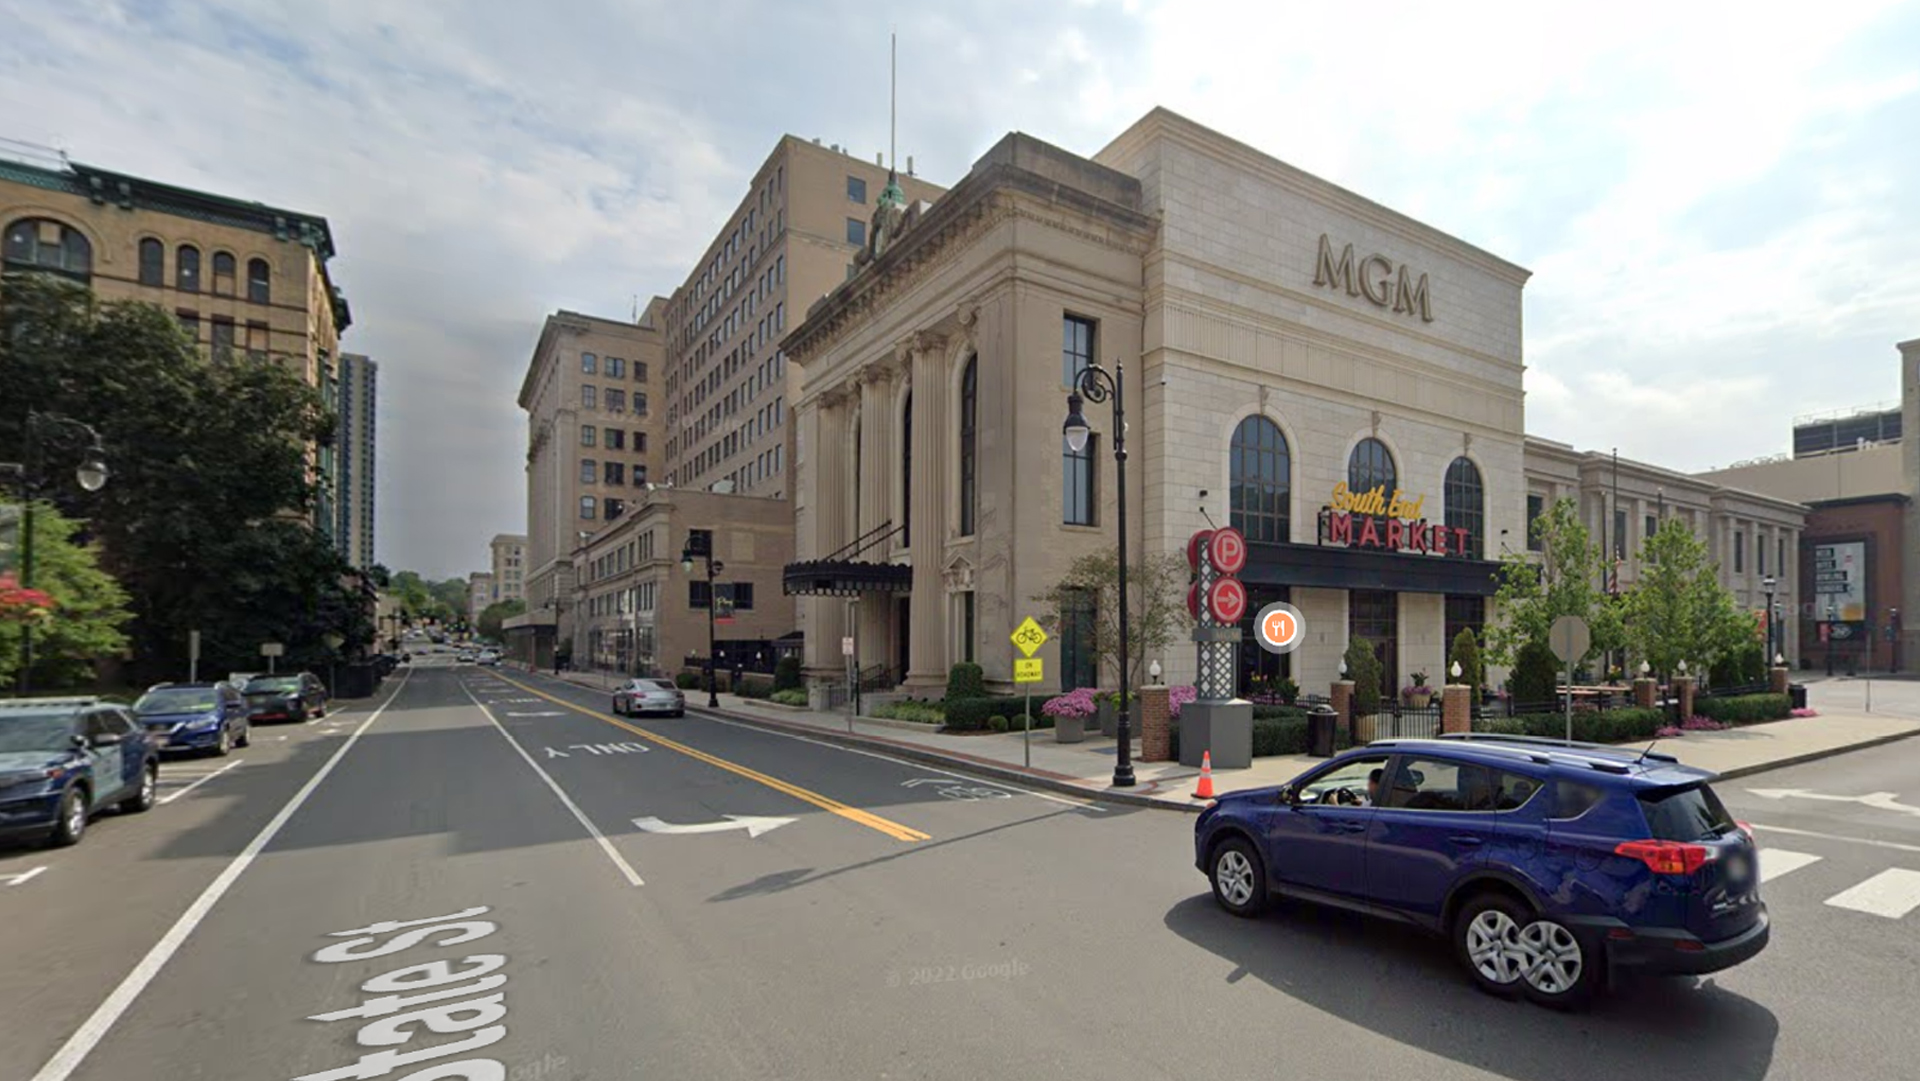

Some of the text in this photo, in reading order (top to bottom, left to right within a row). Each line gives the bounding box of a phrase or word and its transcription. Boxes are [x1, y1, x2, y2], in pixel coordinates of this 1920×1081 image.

[1312, 233, 1434, 323] MGM
[1330, 481, 1426, 519] South End
[1221, 537, 1239, 563] P
[1329, 512, 1469, 557] MARKET
[545, 742, 650, 759] ONLY
